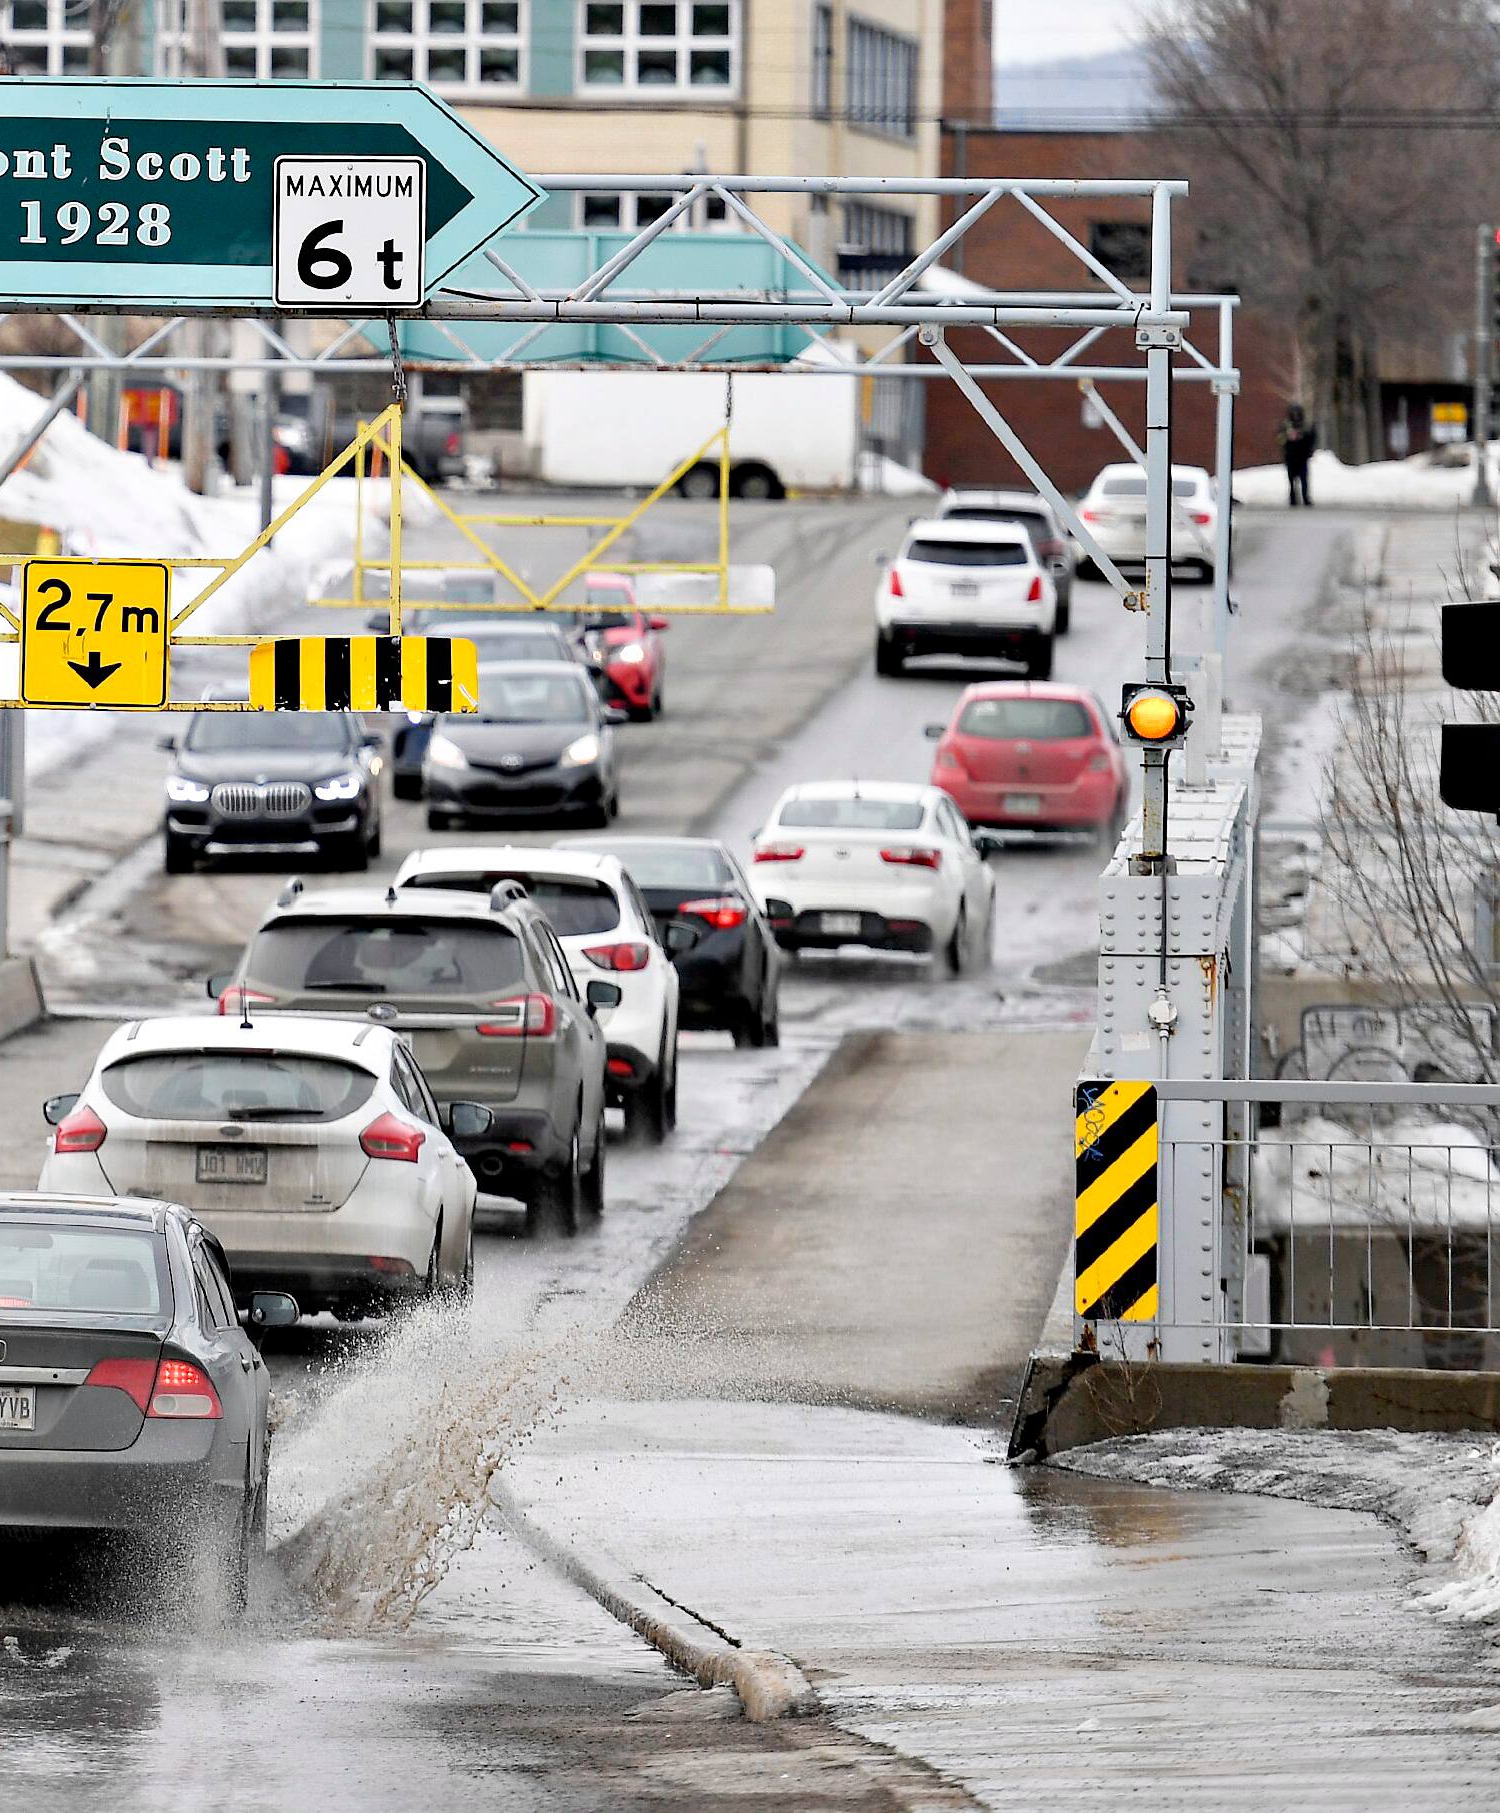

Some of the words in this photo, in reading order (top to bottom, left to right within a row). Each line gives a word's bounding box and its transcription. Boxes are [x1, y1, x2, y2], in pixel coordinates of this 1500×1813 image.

[100, 137, 253, 183] Scott
[285, 174, 413, 198] MAXIMUM
[18, 200, 172, 247] 1928
[297, 219, 353, 290] 6
[375, 241, 404, 290] t
